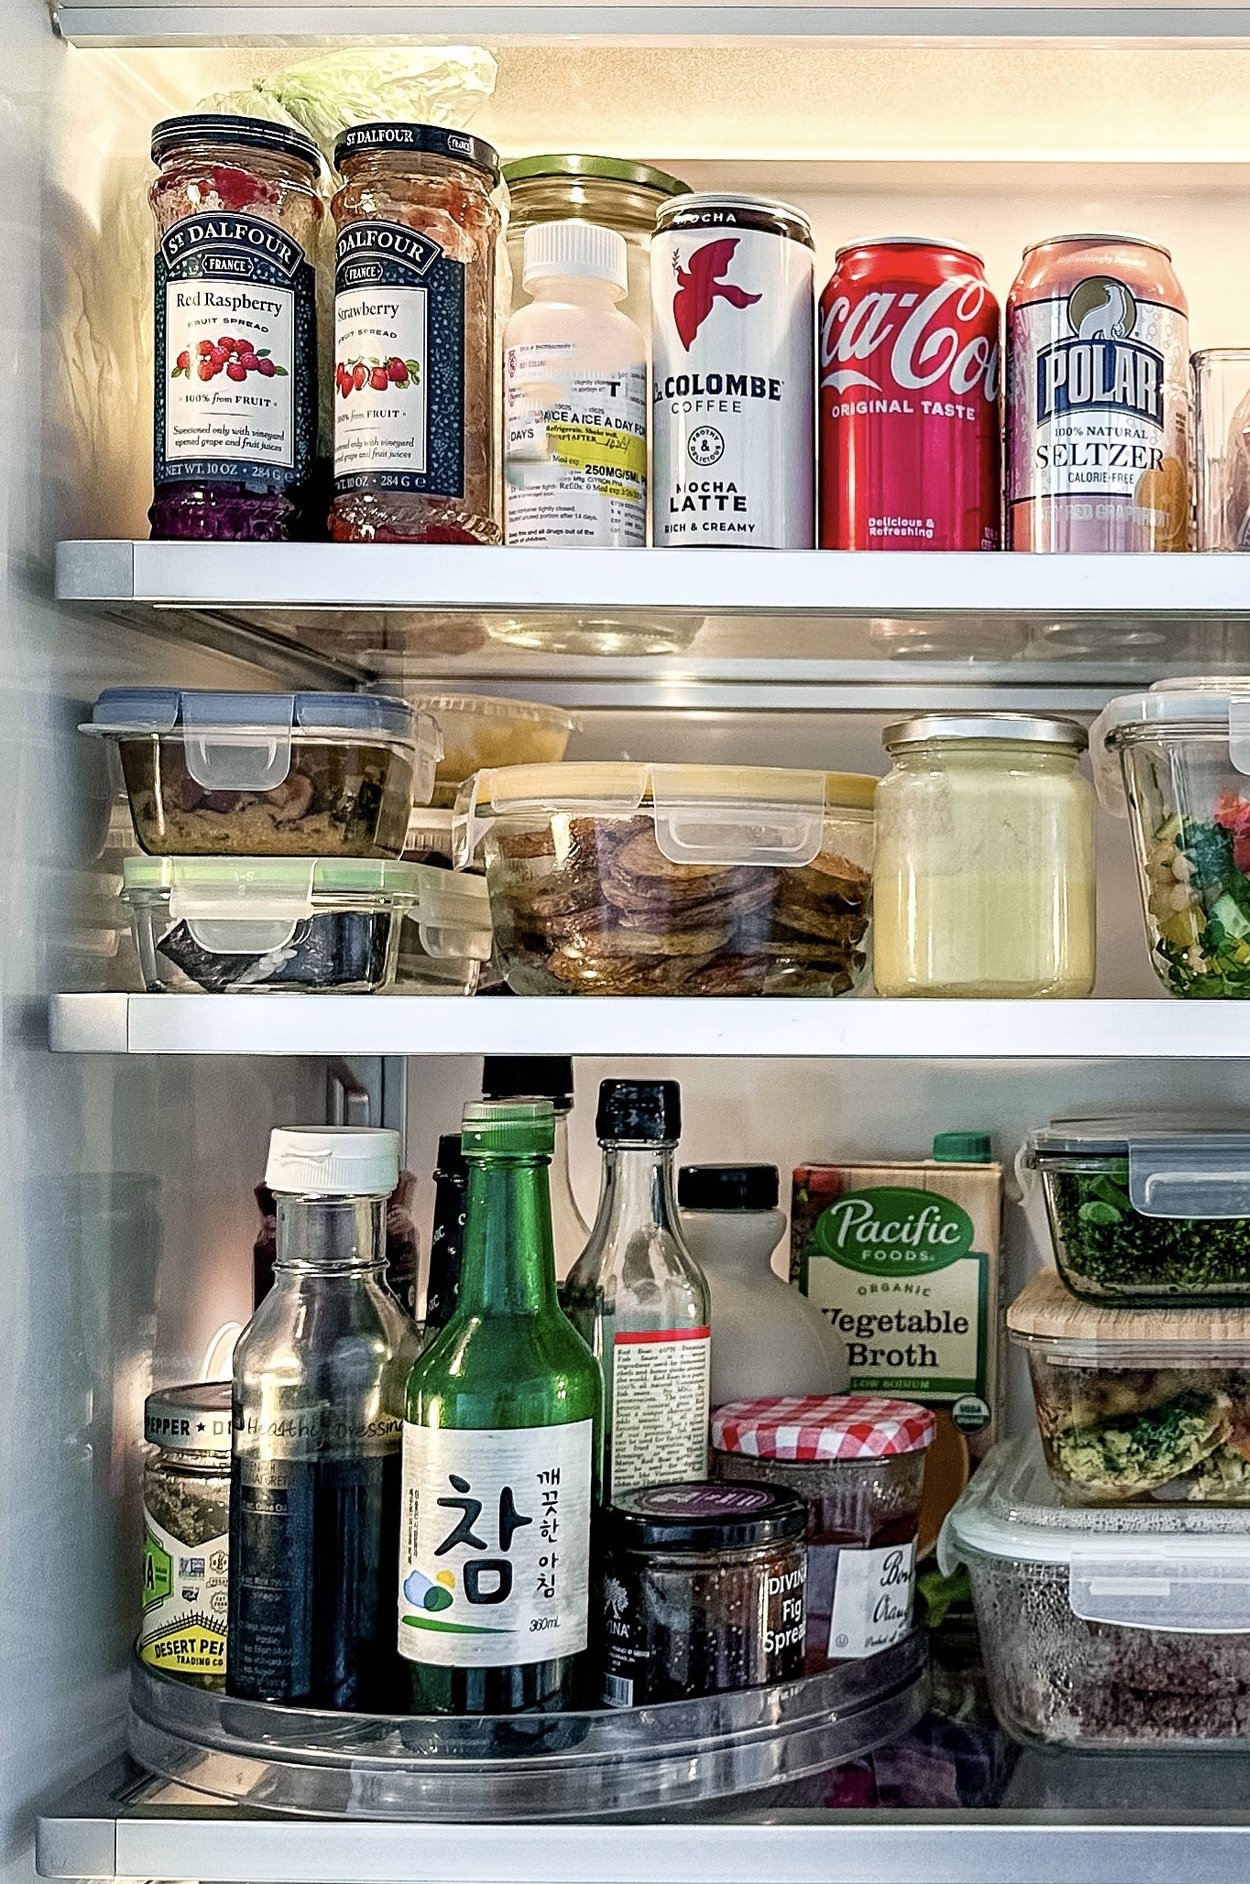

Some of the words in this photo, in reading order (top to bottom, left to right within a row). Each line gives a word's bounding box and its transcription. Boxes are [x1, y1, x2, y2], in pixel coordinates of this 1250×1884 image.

[357, 129, 414, 144] DALFOUR
[680, 212, 737, 224] OCHA
[188, 222, 292, 264] DALFOUR
[338, 231, 424, 262] DALFOUR
[209, 258, 246, 272] FRANCE
[349, 266, 377, 280] FRANCE
[176, 292, 201, 308] Red
[204, 292, 283, 317] Raspberry
[187, 317, 218, 328] FRUIT
[223, 318, 270, 333] SPREAD
[357, 328, 398, 339] SPREAD
[664, 373, 781, 401] COLOMBE
[1043, 344, 1160, 416] POLAR
[185, 393, 210, 404] 100%
[235, 395, 271, 407] FRUIT
[671, 399, 742, 414] COFFEE
[366, 409, 400, 418] FRUIT
[832, 400, 914, 418] ORIGINAL
[921, 400, 976, 421] TASTE
[615, 418, 634, 432] DAY
[1054, 425, 1083, 437] 100%
[1086, 426, 1149, 440] NATURAL
[511, 428, 534, 441] DAYS
[700, 439, 710, 452] &
[1036, 442, 1165, 472] SELTZER
[165, 465, 183, 476] NET
[207, 464, 218, 475] 10
[219, 464, 239, 475] OZ
[251, 466, 270, 479] 284
[272, 470, 281, 480] G
[1067, 471, 1135, 484] CALORIE-FREE
[355, 475, 369, 487] OZ
[380, 475, 399, 487] 284
[401, 476, 410, 487] G
[670, 495, 747, 513] LATTE
[664, 523, 686, 533] RICH
[690, 522, 698, 531] &
[702, 522, 756, 533] CREAMY
[868, 518, 924, 528] Delicious
[926, 518, 935, 528] &
[869, 527, 934, 538] Refreshing
[830, 1199, 961, 1248] Pacific
[862, 1250, 929, 1262] FOODS
[857, 1283, 931, 1297] ORGANIC
[847, 1343, 939, 1367] Broth
[537, 1467, 561, 1543] 깨끗한
[434, 1474, 533, 1604] 참
[537, 1552, 559, 1598] 아침
[783, 1598, 802, 1622] Fig
[763, 1623, 806, 1655] Sprea
[154, 1639, 196, 1659] DESERT
[176, 1655, 210, 1666] TRADING
